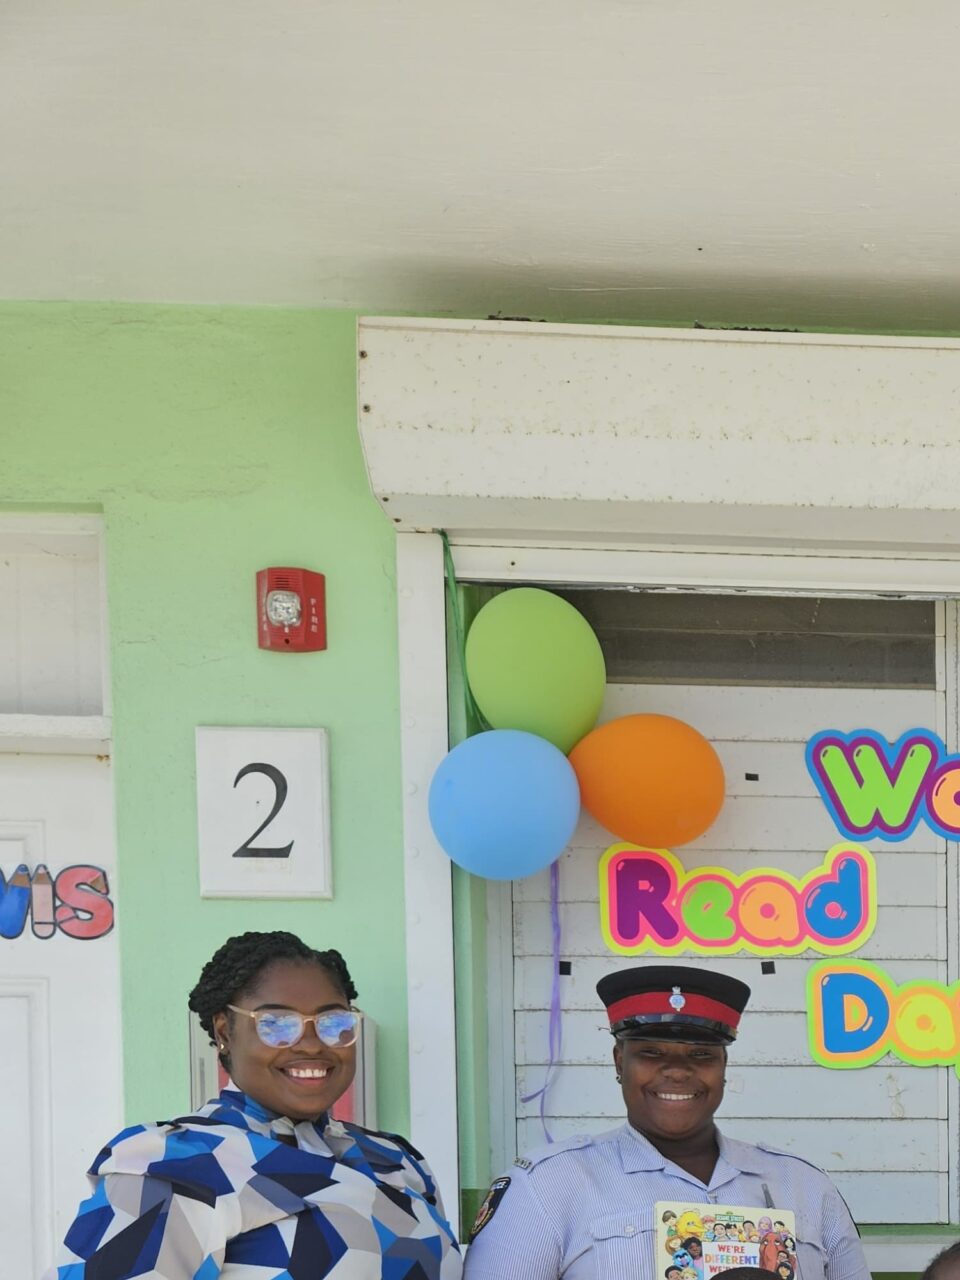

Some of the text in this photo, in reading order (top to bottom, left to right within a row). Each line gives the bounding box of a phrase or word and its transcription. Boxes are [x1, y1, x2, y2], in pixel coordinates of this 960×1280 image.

[232, 762, 295, 858] 2
[608, 850, 870, 948] Read
[718, 1244, 745, 1254] WE'RE
